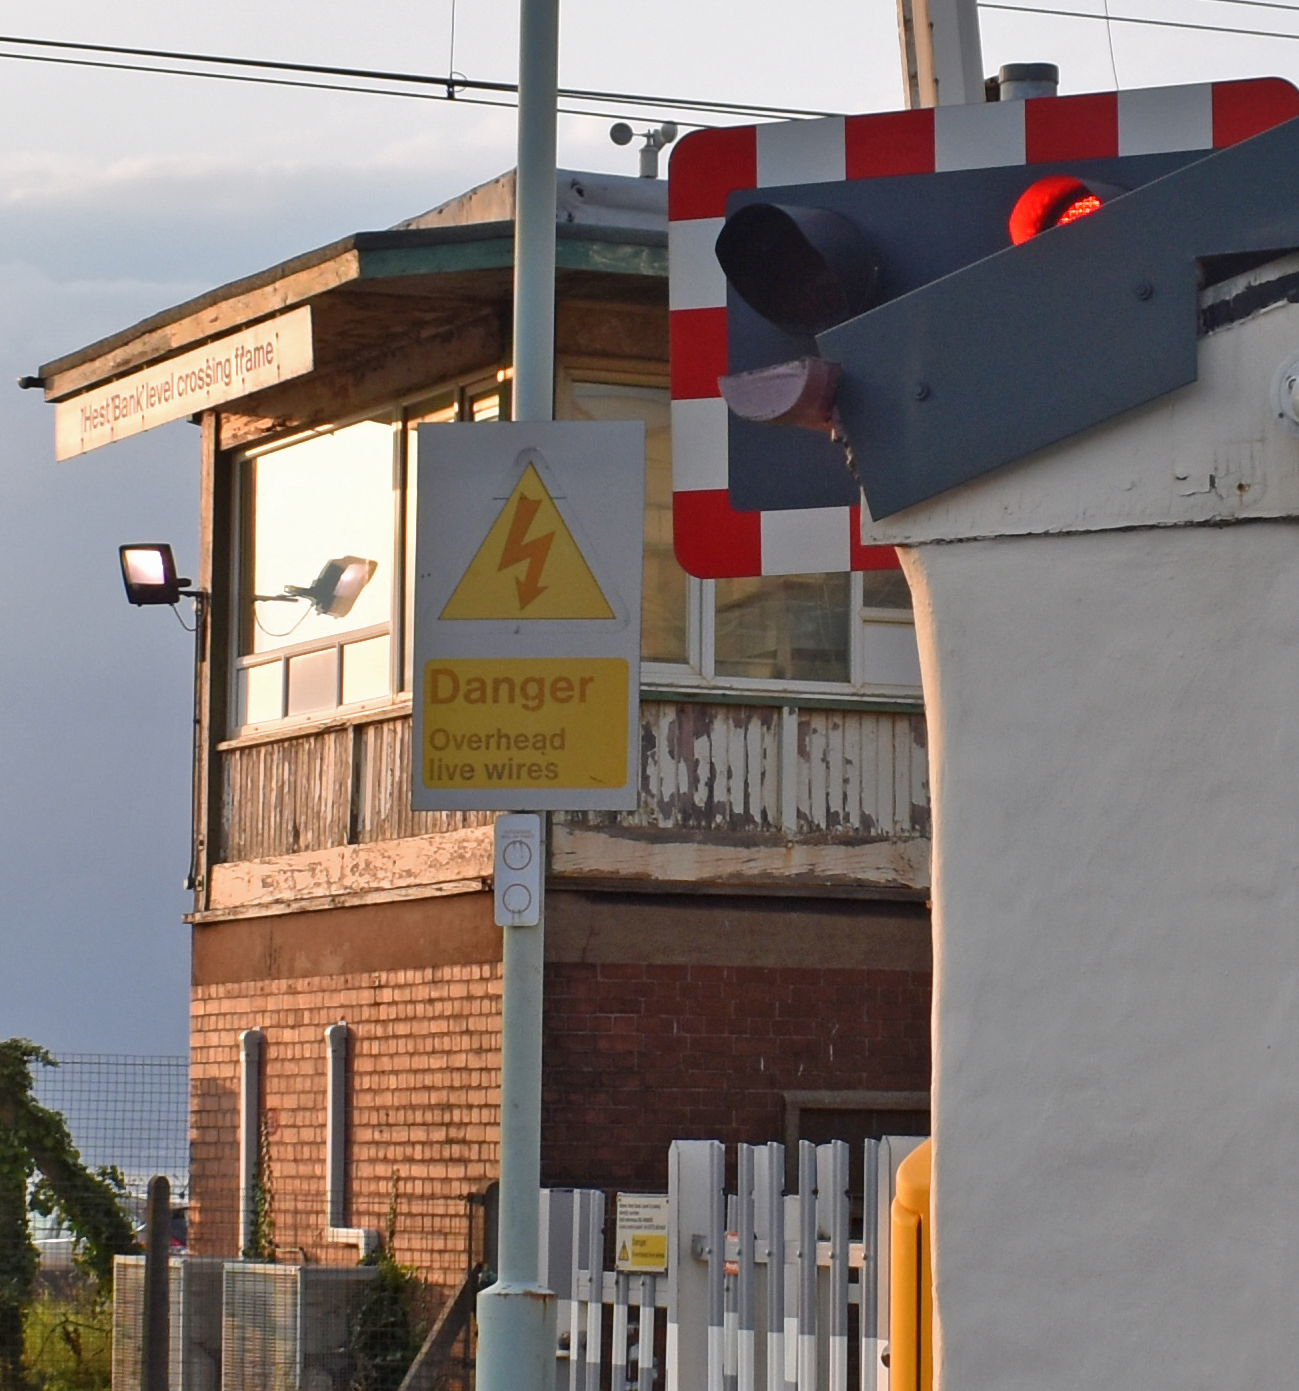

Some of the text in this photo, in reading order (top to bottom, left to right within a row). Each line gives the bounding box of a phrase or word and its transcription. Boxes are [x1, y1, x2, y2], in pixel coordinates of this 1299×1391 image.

[83, 341, 274, 432] Hest Bank level crossing frame
[430, 668, 594, 712] Danger
[429, 728, 565, 751] Overhead
[429, 758, 559, 781] live wires
